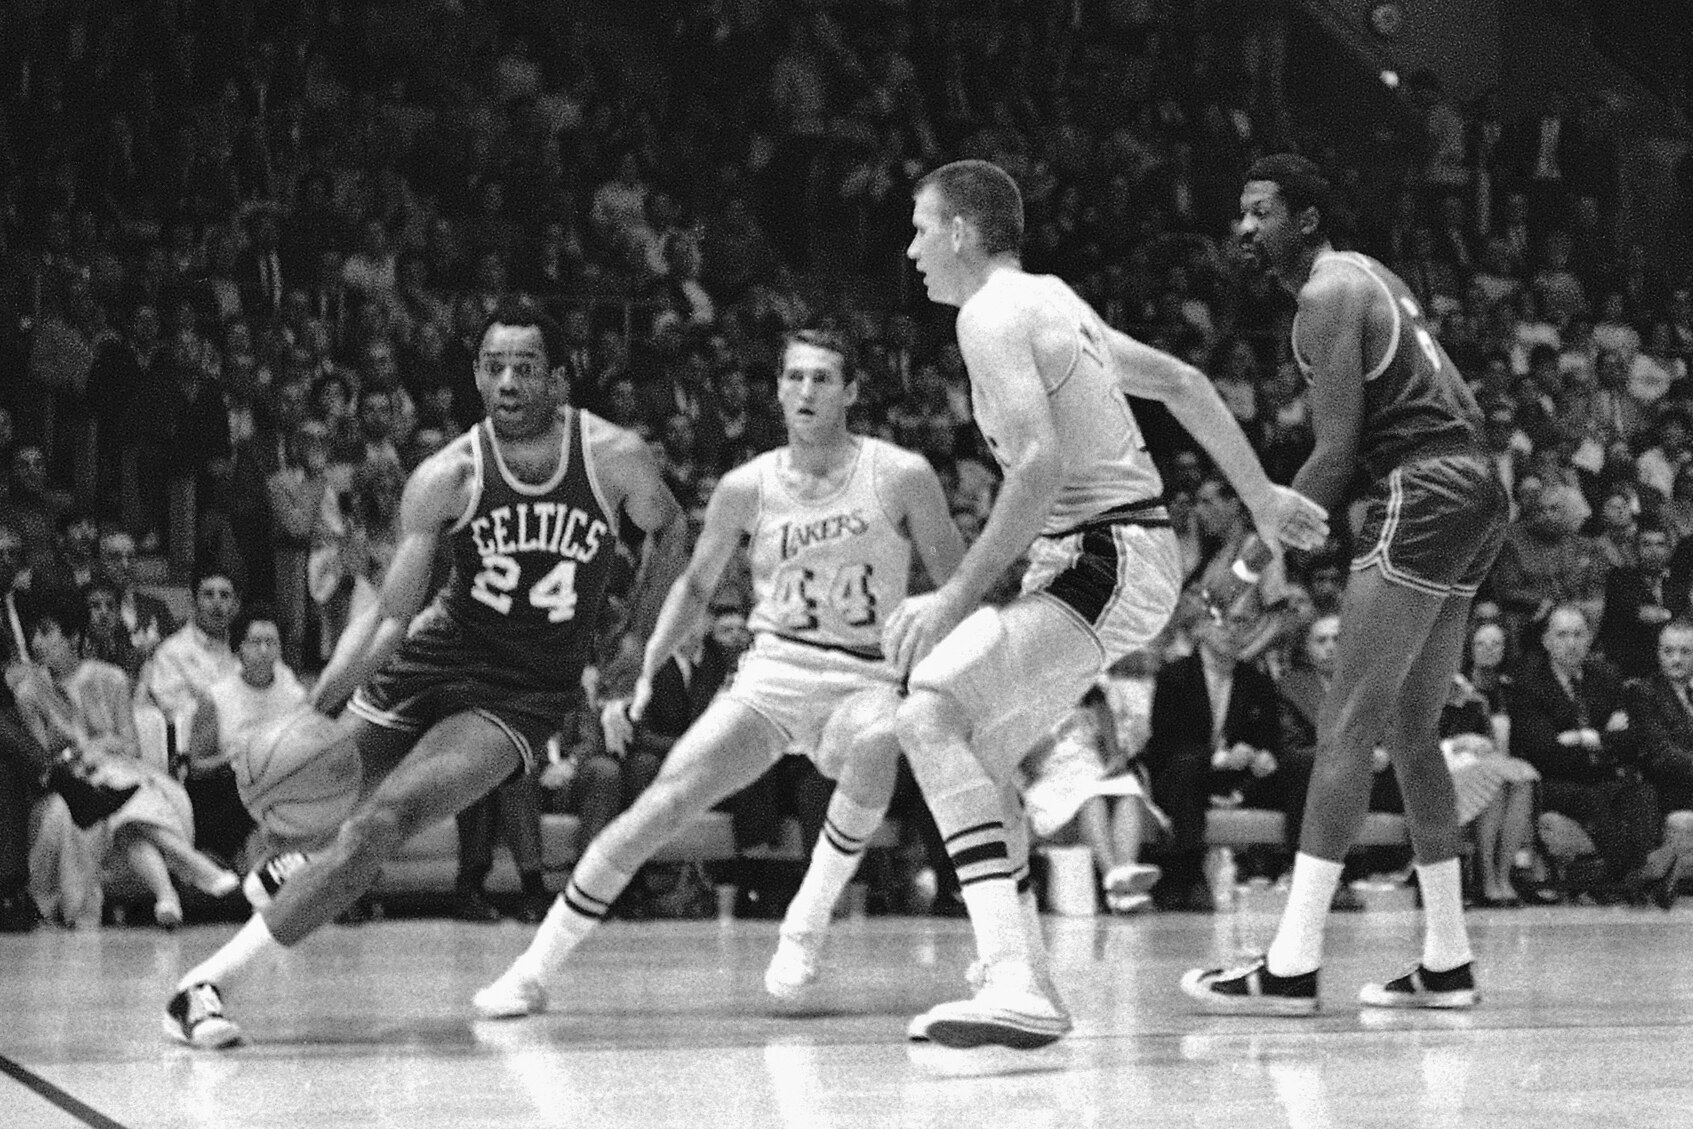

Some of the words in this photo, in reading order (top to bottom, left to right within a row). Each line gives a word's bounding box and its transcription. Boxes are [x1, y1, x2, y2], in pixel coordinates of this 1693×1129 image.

[471, 502, 608, 563] CELTICS
[781, 509, 869, 560] LAKERS
[471, 554, 578, 623] 24
[772, 563, 876, 631] 44
